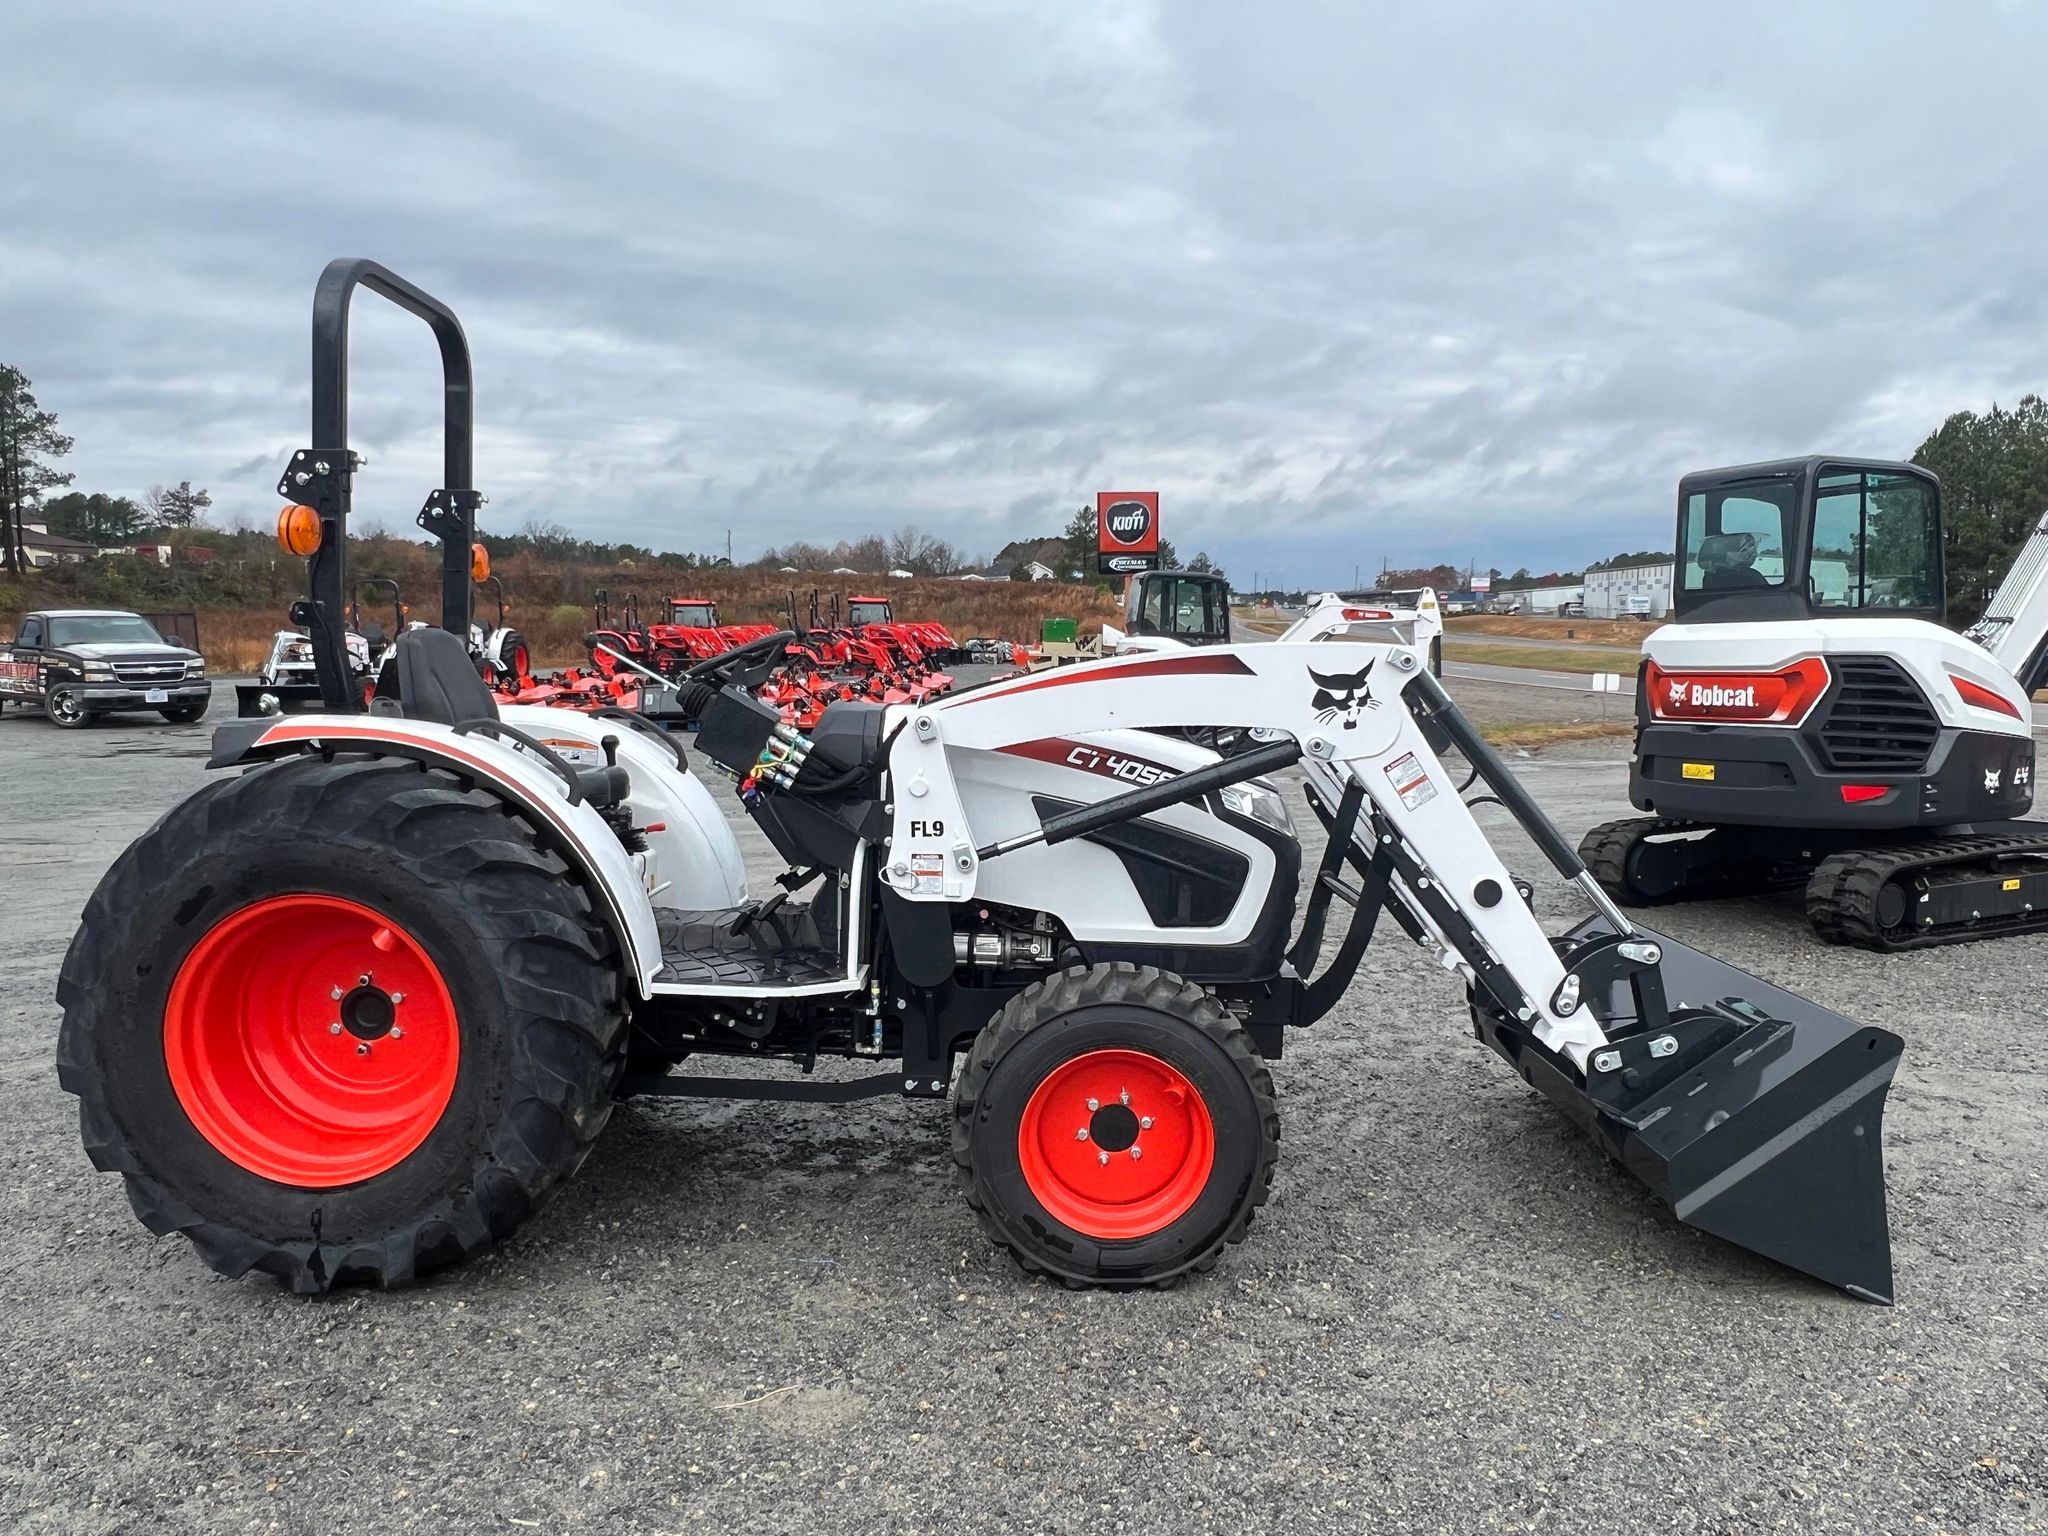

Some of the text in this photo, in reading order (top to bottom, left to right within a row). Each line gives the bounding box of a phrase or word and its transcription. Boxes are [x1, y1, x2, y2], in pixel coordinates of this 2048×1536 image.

[1112, 514, 1145, 531] KIOTI
[1691, 684, 1755, 707] Bobcat
[910, 820, 945, 838] FL9
